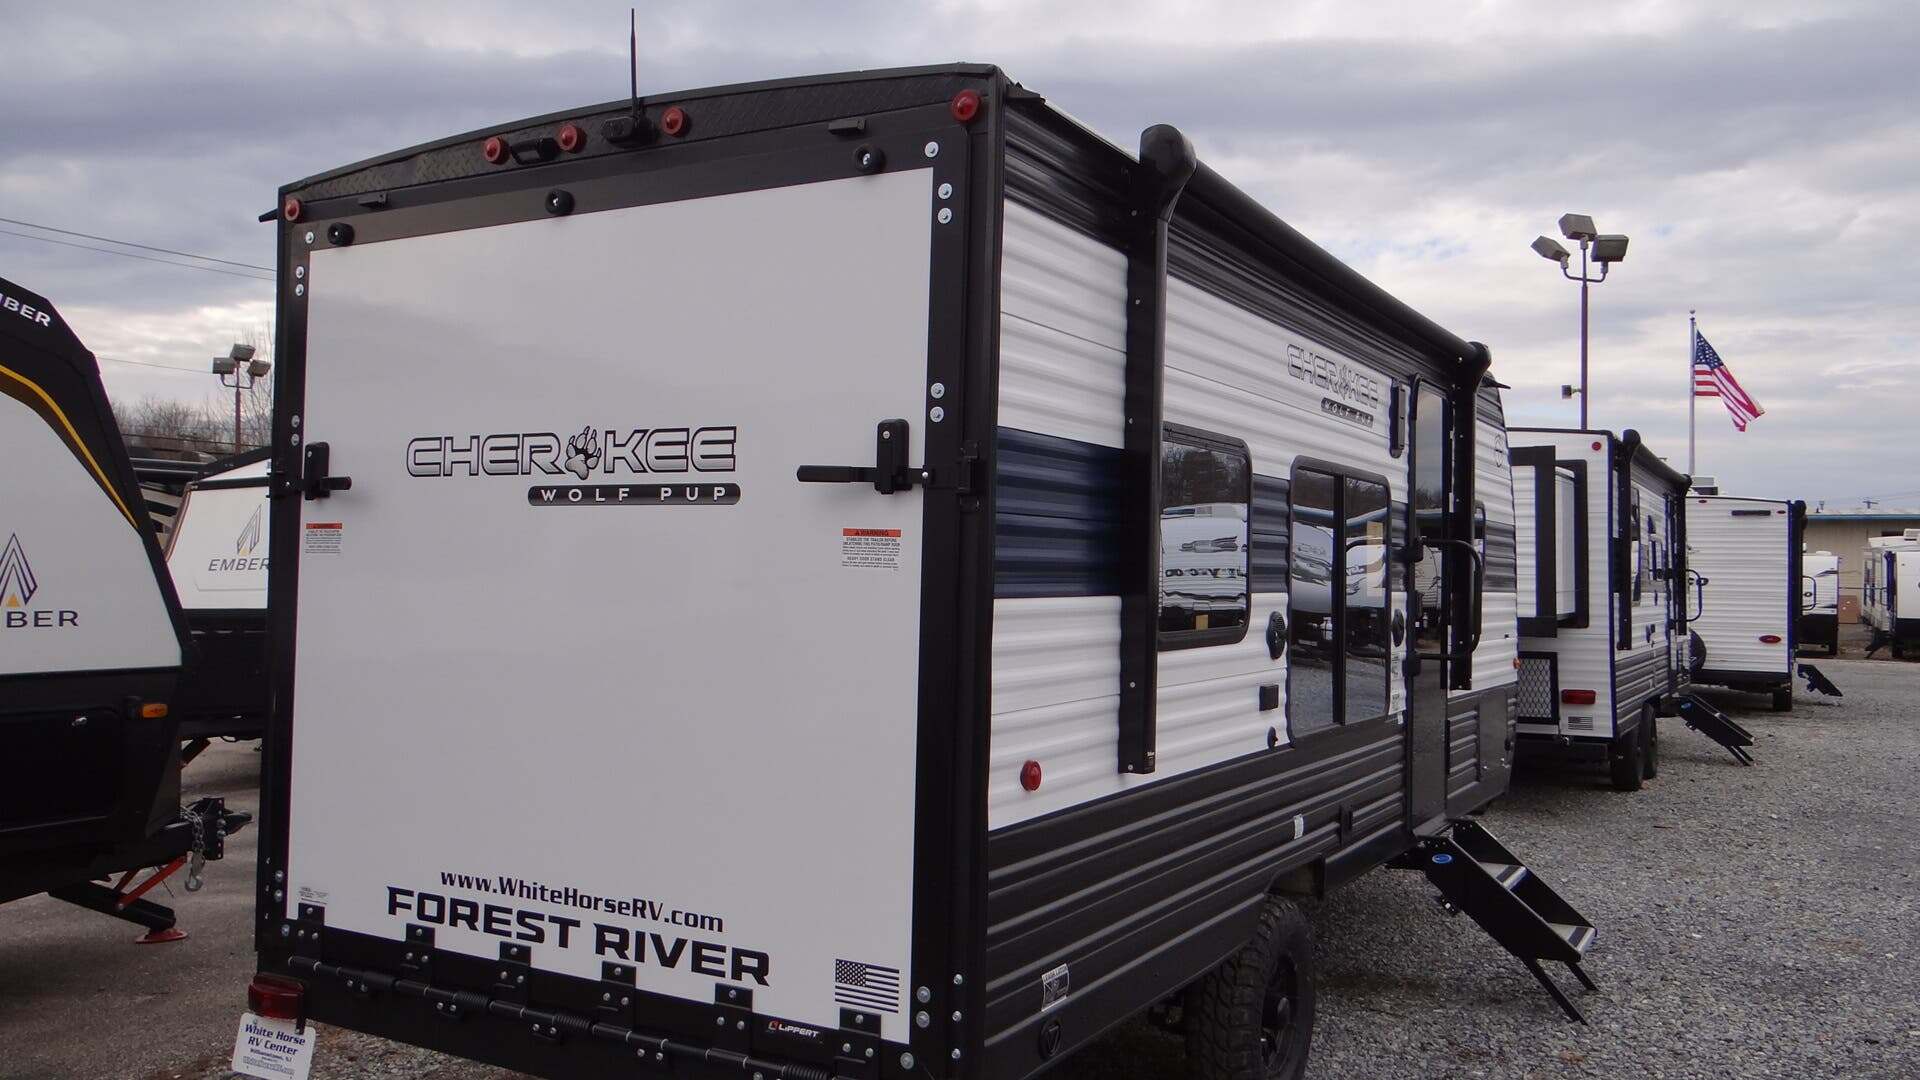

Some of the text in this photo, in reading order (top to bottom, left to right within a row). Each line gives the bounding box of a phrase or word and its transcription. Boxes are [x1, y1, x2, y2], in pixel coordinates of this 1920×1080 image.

[0, 293, 51, 327] BER
[541, 486, 726, 503] WOLF PUP
[440, 871, 724, 932] www.WhiteHorseRV.com
[386, 886, 770, 987] FOREST RIVER
[245, 1024, 306, 1046] White Horse
[248, 1036, 299, 1056] RV Center
